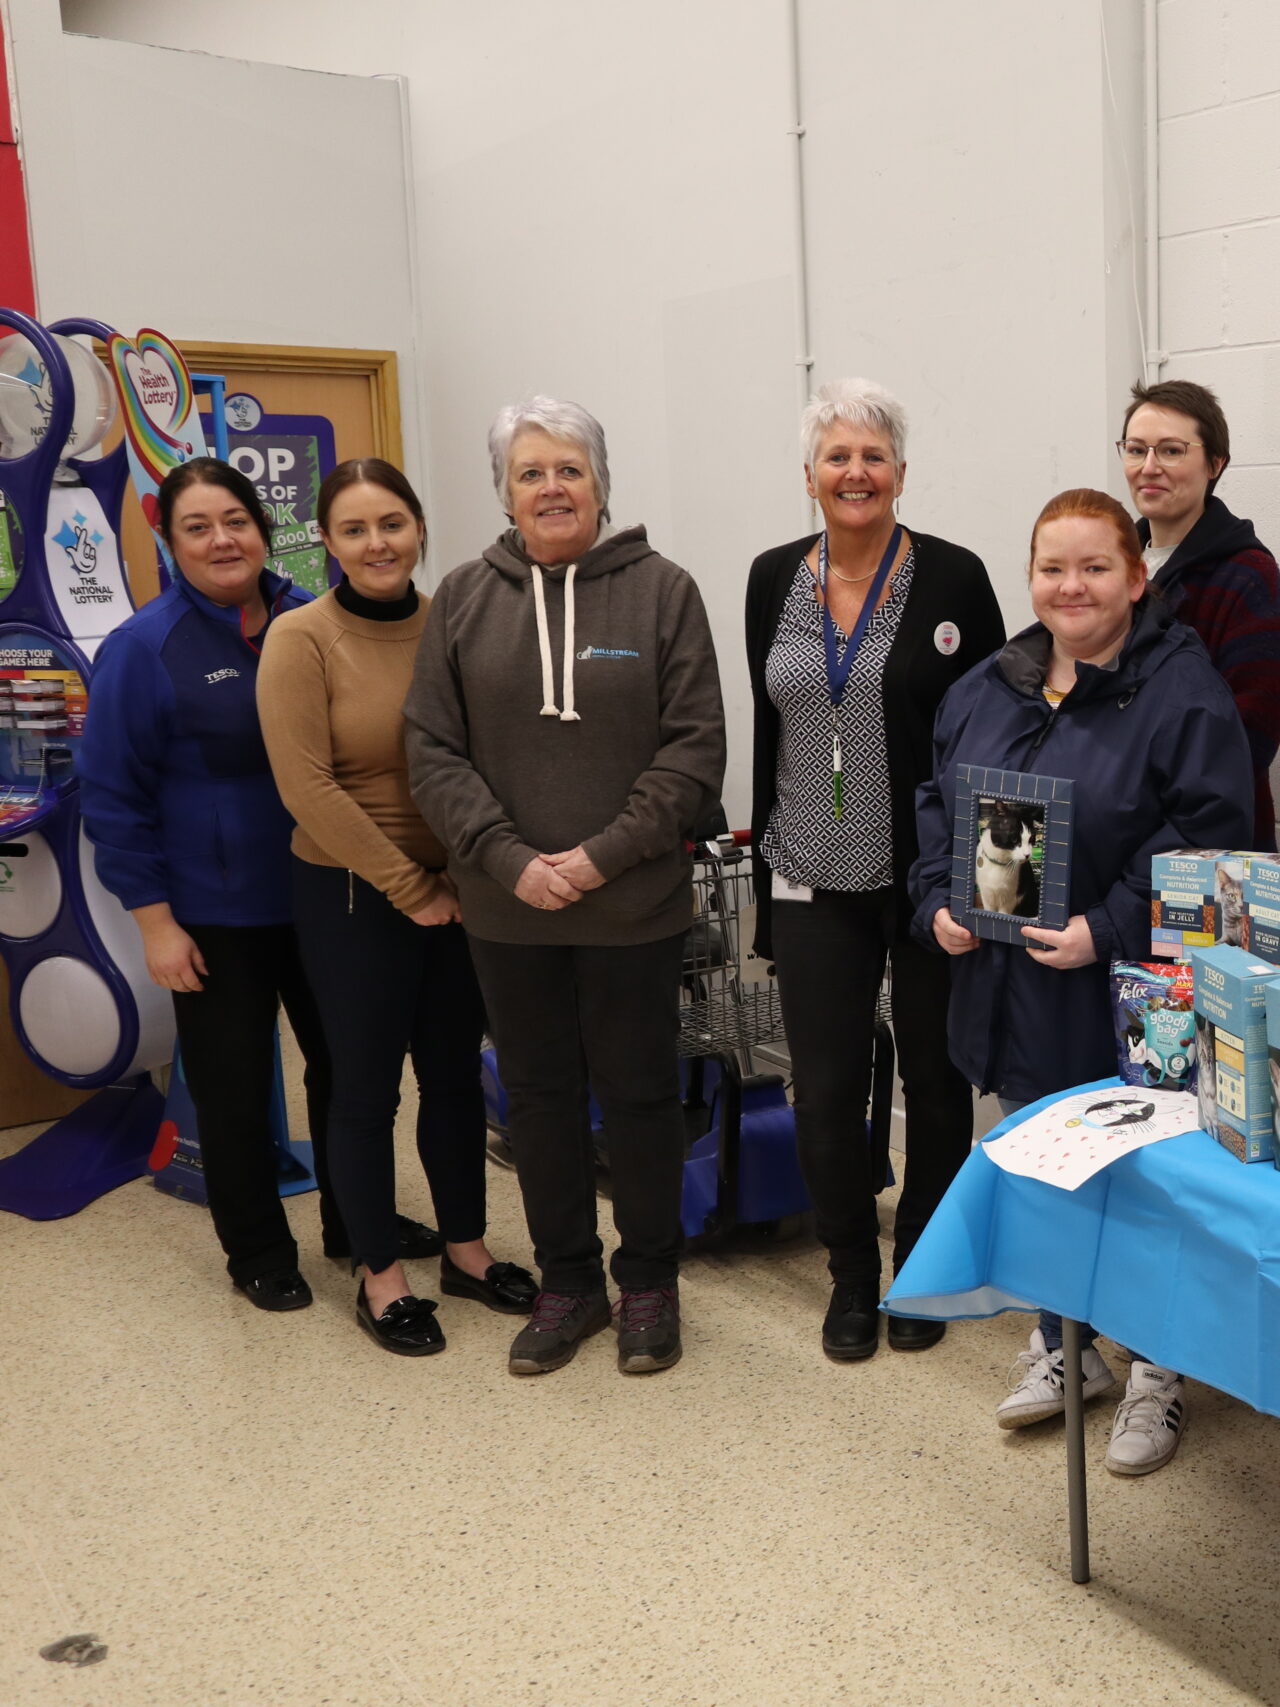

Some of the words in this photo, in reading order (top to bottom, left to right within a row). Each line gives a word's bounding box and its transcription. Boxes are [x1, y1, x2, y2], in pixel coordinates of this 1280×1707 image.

[140, 368, 152, 376] The
[139, 373, 170, 389] Health
[142, 391, 176, 406] Lottery
[79, 577, 98, 586] THE
[69, 586, 114, 595] NATIONAL
[74, 595, 113, 604] LOTTERY
[29, 649, 54, 658] YOUR
[592, 648, 639, 658] MILLSTREAM
[27, 658, 52, 667] HERE
[204, 668, 241, 682] TESCO
[1168, 861, 1198, 871] TESCO
[1257, 867, 1280, 880] TESCO
[1166, 881, 1200, 890] NUTRITION
[1255, 889, 1280, 902] NUTRITION
[1177, 915, 1195, 923] JELLY
[1255, 934, 1262, 942] IN
[1262, 936, 1279, 946] GRAVY
[1203, 965, 1225, 988] TESCO
[1118, 982, 1149, 1003] felix
[1202, 999, 1228, 1021] NUTRITION
[1150, 1011, 1189, 1032] goody
[1156, 1023, 1179, 1038] bag
